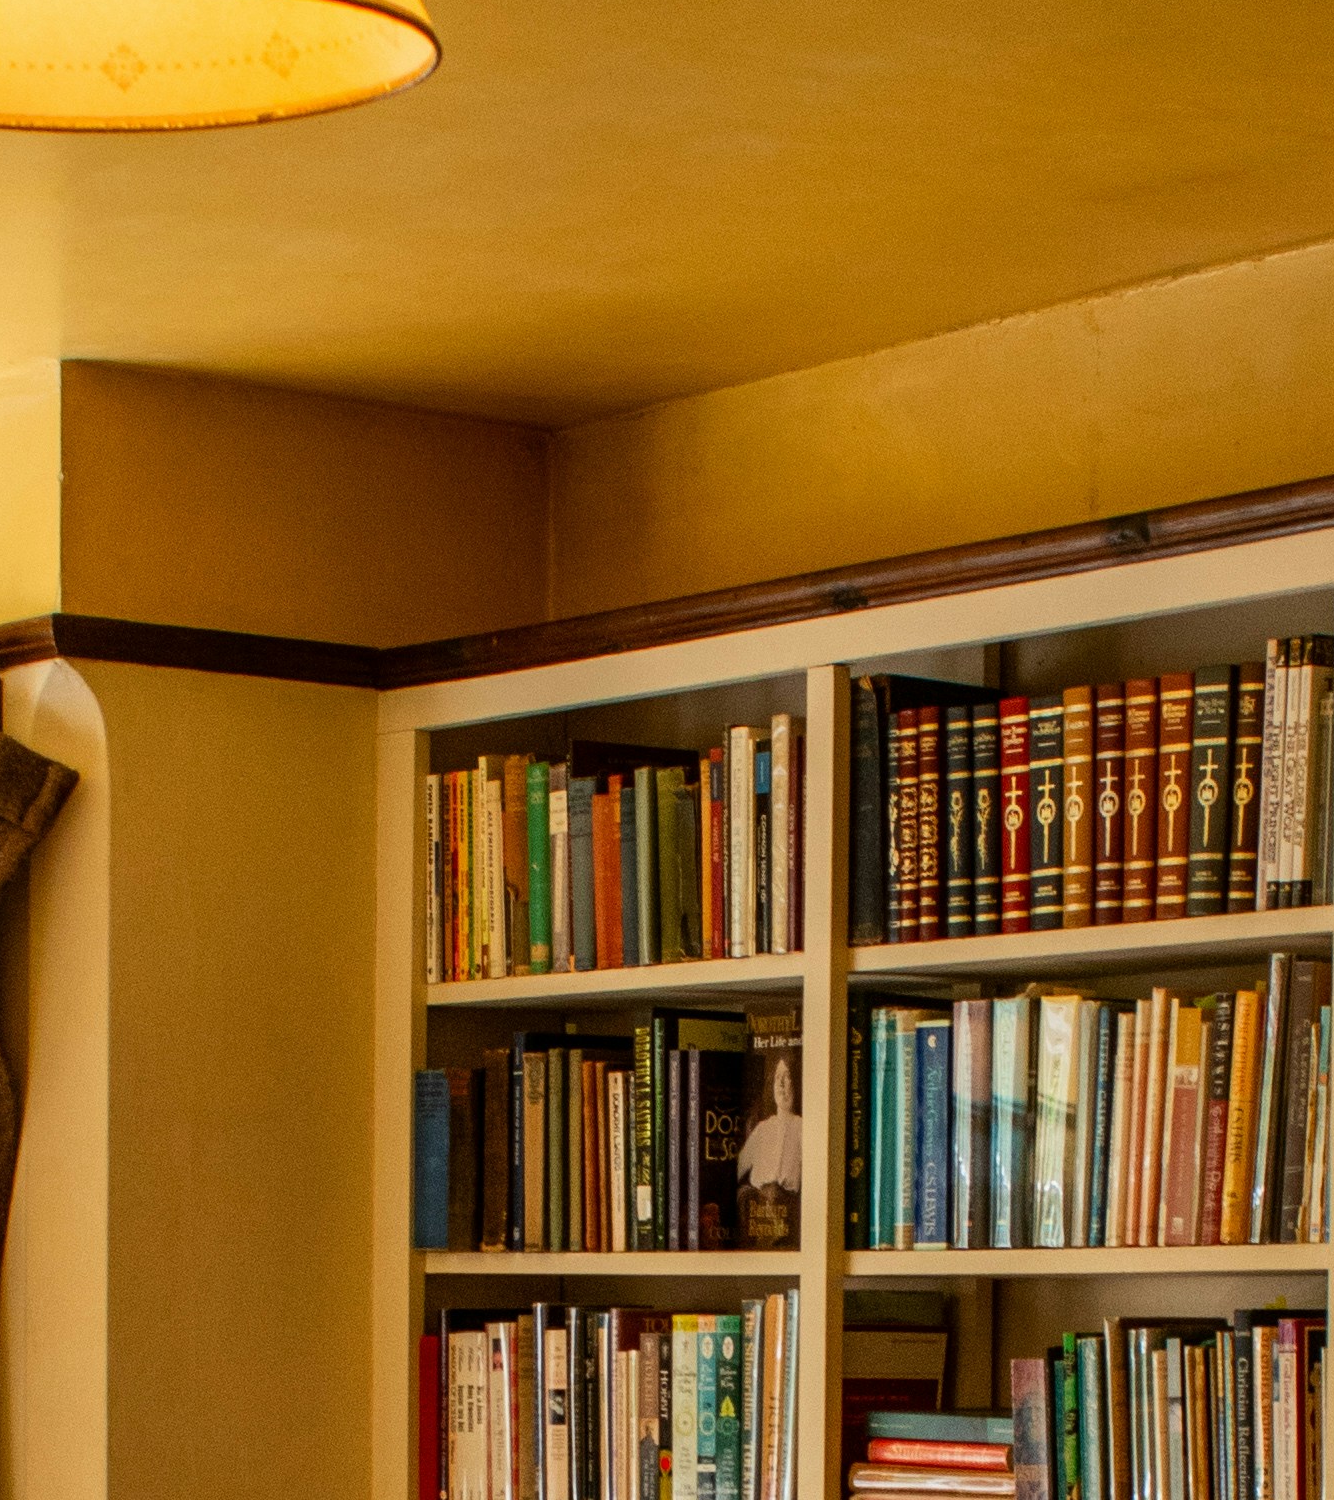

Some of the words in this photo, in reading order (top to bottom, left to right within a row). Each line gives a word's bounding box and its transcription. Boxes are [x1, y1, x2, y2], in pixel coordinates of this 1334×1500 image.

[1270, 723, 1282, 754] THE
[1287, 723, 1297, 750] THE
[1297, 722, 1309, 750] THE
[1269, 754, 1282, 798] LIGHT
[1285, 756, 1297, 797] GRAY
[1294, 755, 1307, 814] GOLDEN
[1267, 801, 1281, 864] PRINCESS
[1283, 801, 1295, 843] WOLF
[1293, 817, 1305, 848] KEY
[635, 1026, 651, 1084] DOROTHY
[753, 1036, 769, 1049] Her
[770, 1035, 787, 1048] Life
[1099, 1028, 1111, 1081] LETTERS
[851, 1049, 862, 1090] Hunting
[925, 1066, 940, 1107] Arthur
[851, 1091, 862, 1108] the
[635, 1100, 651, 1147] SAYERS
[851, 1109, 862, 1150] Unicorn
[749, 1199, 788, 1218] Barbara
[743, 1311, 755, 1339] The
[495, 1389, 505, 1426] Charles
[644, 1359, 653, 1418] TOLKIEN
[660, 1369, 669, 1420] HOBBIT
[743, 1343, 755, 1431] Silmarillion
[1237, 1356, 1251, 1421] Christian
[496, 1430, 505, 1471] Williams
